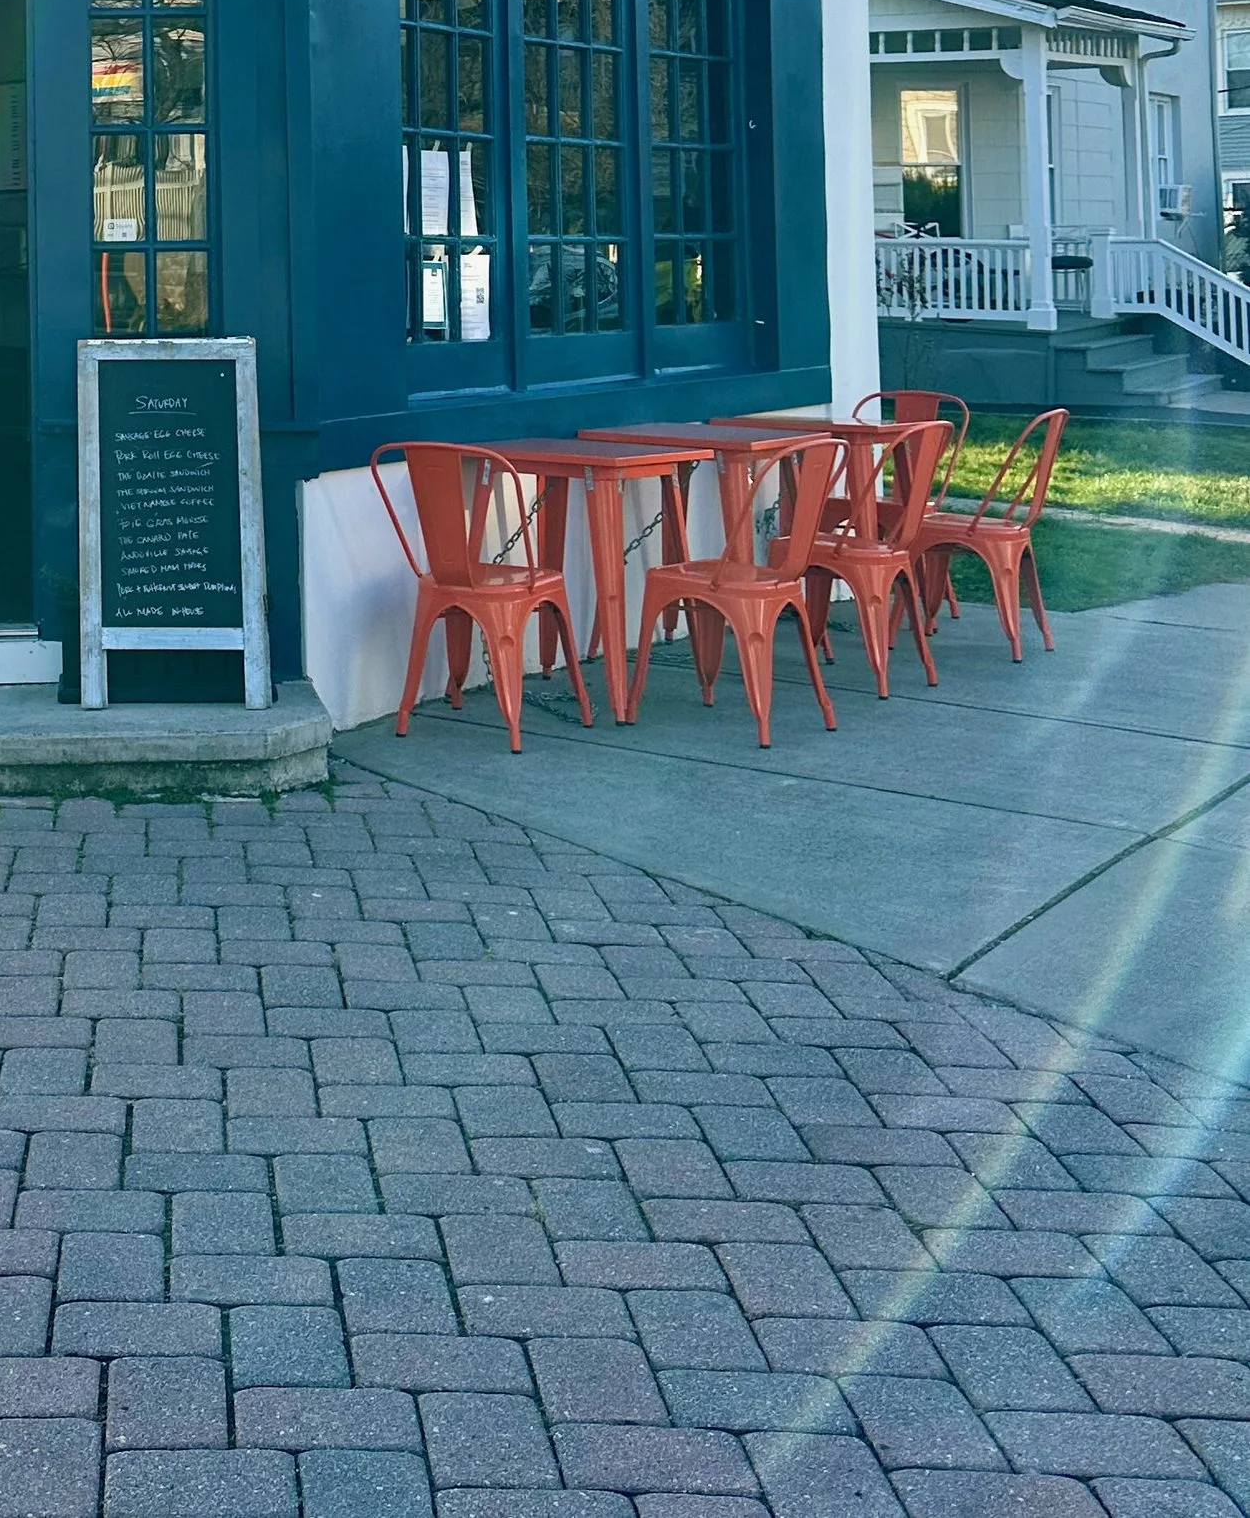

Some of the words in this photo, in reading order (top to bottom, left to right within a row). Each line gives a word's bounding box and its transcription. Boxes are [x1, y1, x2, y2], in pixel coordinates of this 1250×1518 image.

[114, 430, 150, 442] SAUSAGE
[153, 429, 171, 439] EGG
[175, 427, 207, 437] CHEESE
[163, 449, 183, 460] EGG
[186, 449, 221, 461] CHEESE
[117, 471, 132, 481] THE
[170, 468, 211, 478] SANDWICH
[116, 488, 134, 497] THE
[169, 485, 214, 494] SANDWICH
[120, 498, 177, 510] VIETNAMESE
[180, 498, 215, 506] COFFEE
[146, 517, 173, 528] GRAS
[136, 532, 172, 544] CANARD
[121, 565, 157, 576] SMOKED
[136, 606, 163, 617] MADE
